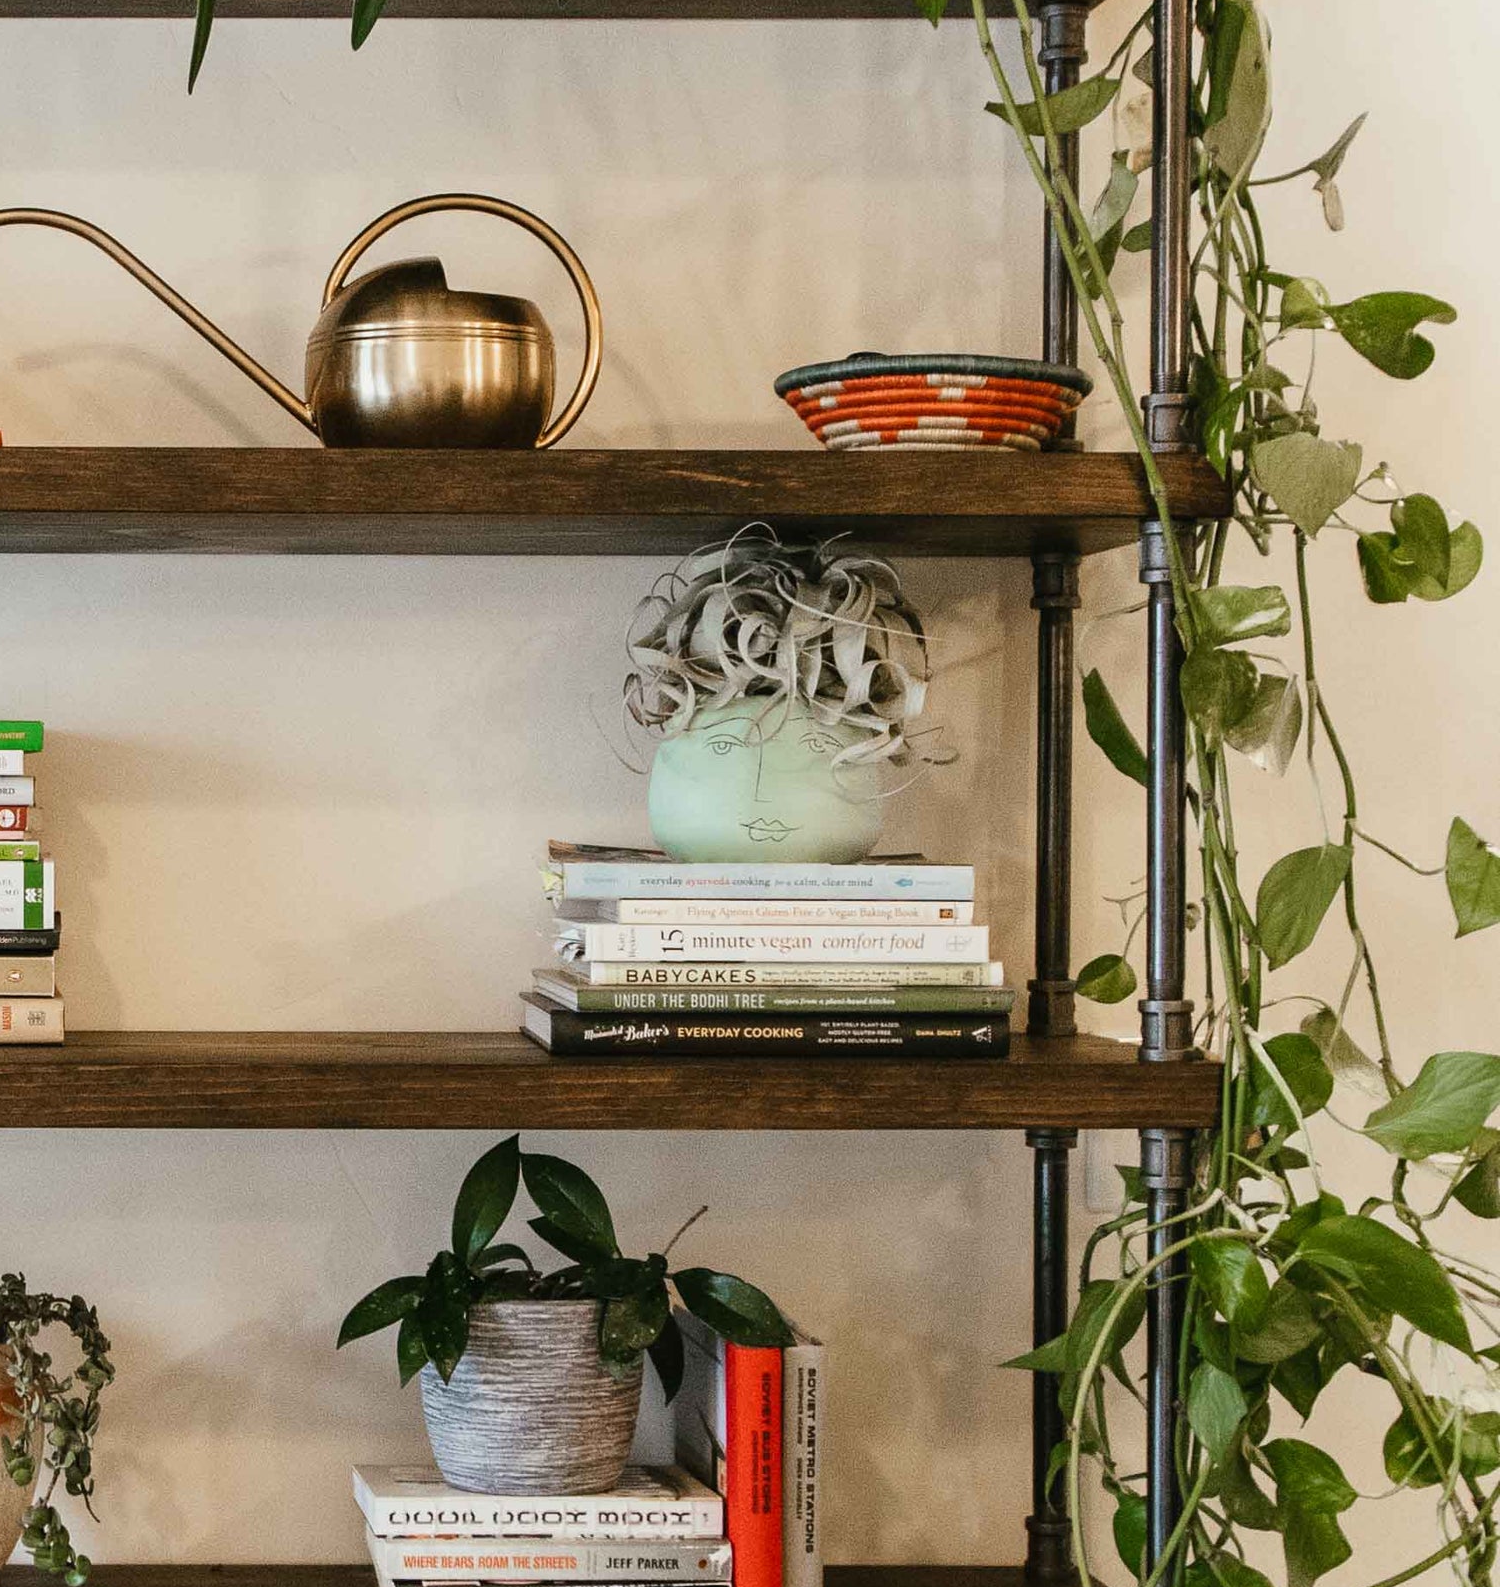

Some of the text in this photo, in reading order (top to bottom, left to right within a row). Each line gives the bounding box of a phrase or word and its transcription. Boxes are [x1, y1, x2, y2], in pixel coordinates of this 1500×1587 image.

[639, 875, 771, 888] everyday cooking
[661, 929, 926, 953] 15 minute vegan comfort food
[626, 969, 757, 984] BABYCAKES
[614, 993, 766, 1009] UNDER THE BODHI TREE
[677, 1027, 804, 1039] EVERYDAY COOKING
[805, 1368, 816, 1554] SOVIET METRO STATIONS
[493, 1511, 691, 1525] COOK BOOK
[404, 1556, 577, 1570] WHERE BEARS ROAM THE STREETS
[606, 1557, 680, 1570] JEFF PARKER
